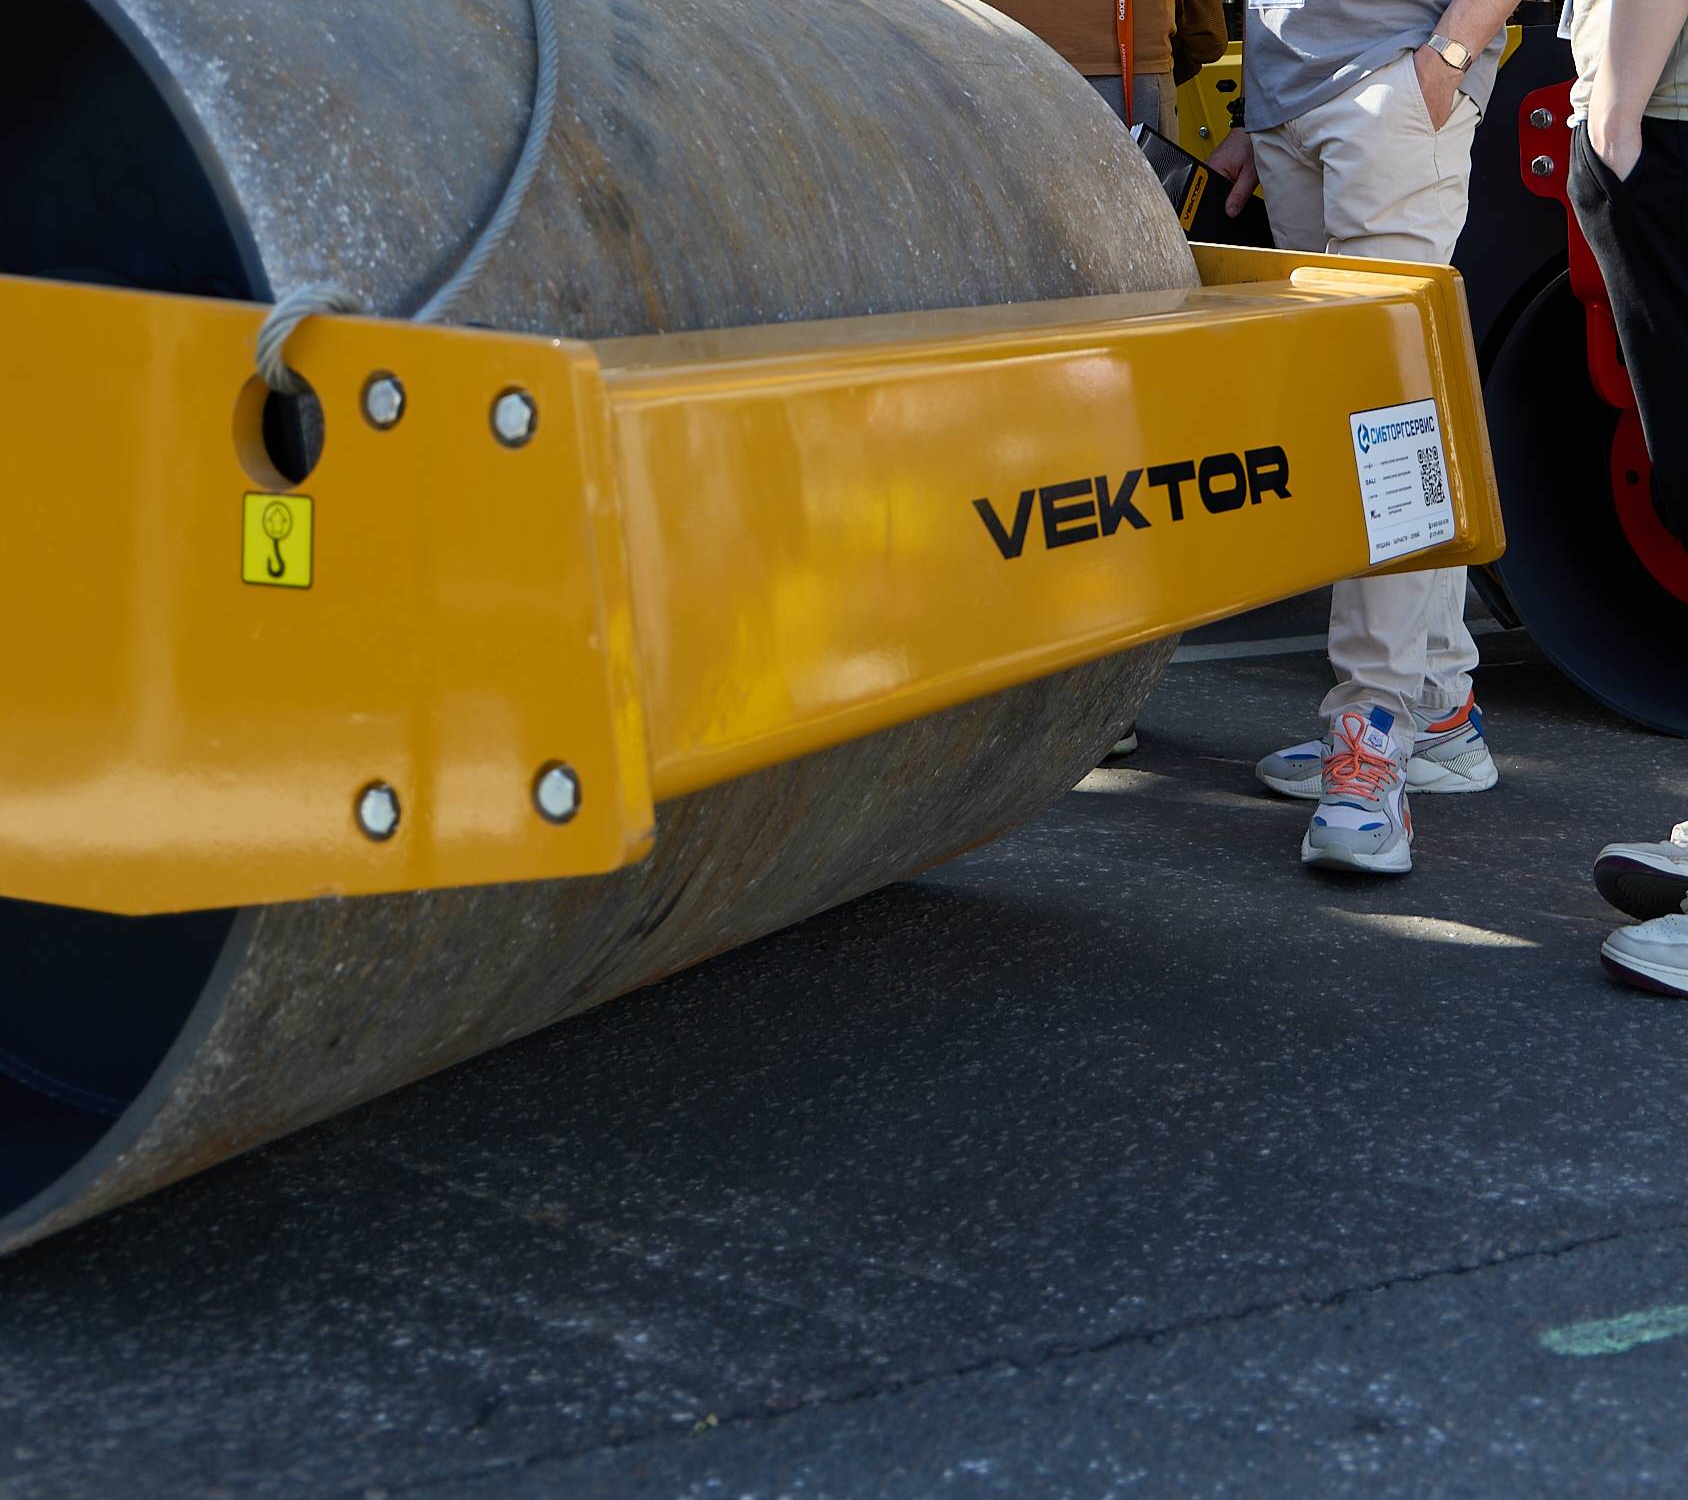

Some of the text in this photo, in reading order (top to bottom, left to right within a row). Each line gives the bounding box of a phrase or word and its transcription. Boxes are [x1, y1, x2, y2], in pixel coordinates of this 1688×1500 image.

[1184, 175, 1203, 220] VEKTOR
[1370, 416, 1435, 445] СИБТОРГСЕРВИС
[972, 445, 1292, 560] VEKTOR
